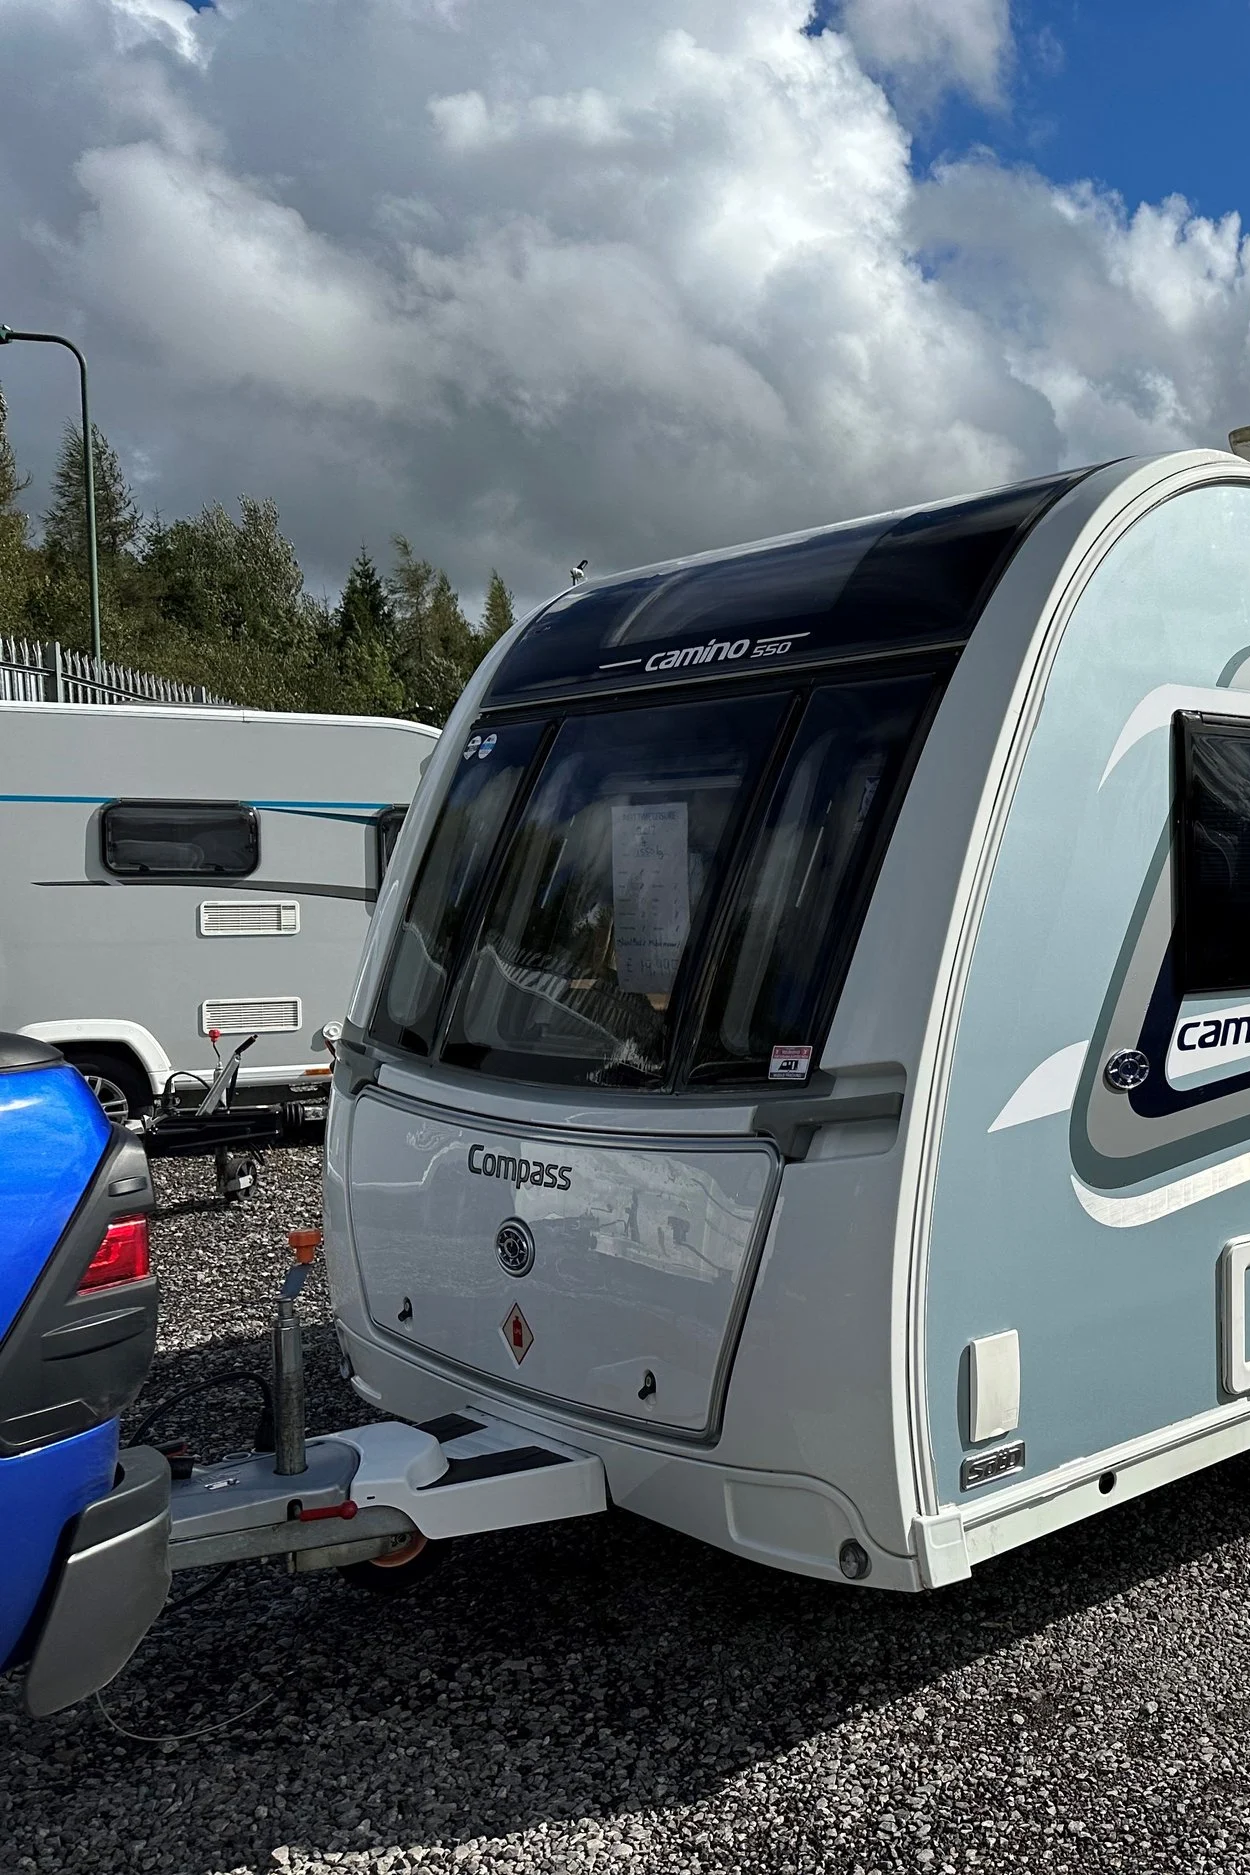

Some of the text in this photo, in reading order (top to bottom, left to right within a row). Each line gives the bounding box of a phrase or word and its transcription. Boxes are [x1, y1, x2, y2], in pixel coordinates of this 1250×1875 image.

[645, 638, 792, 672] camino 550
[467, 1143, 573, 1191] Compass
